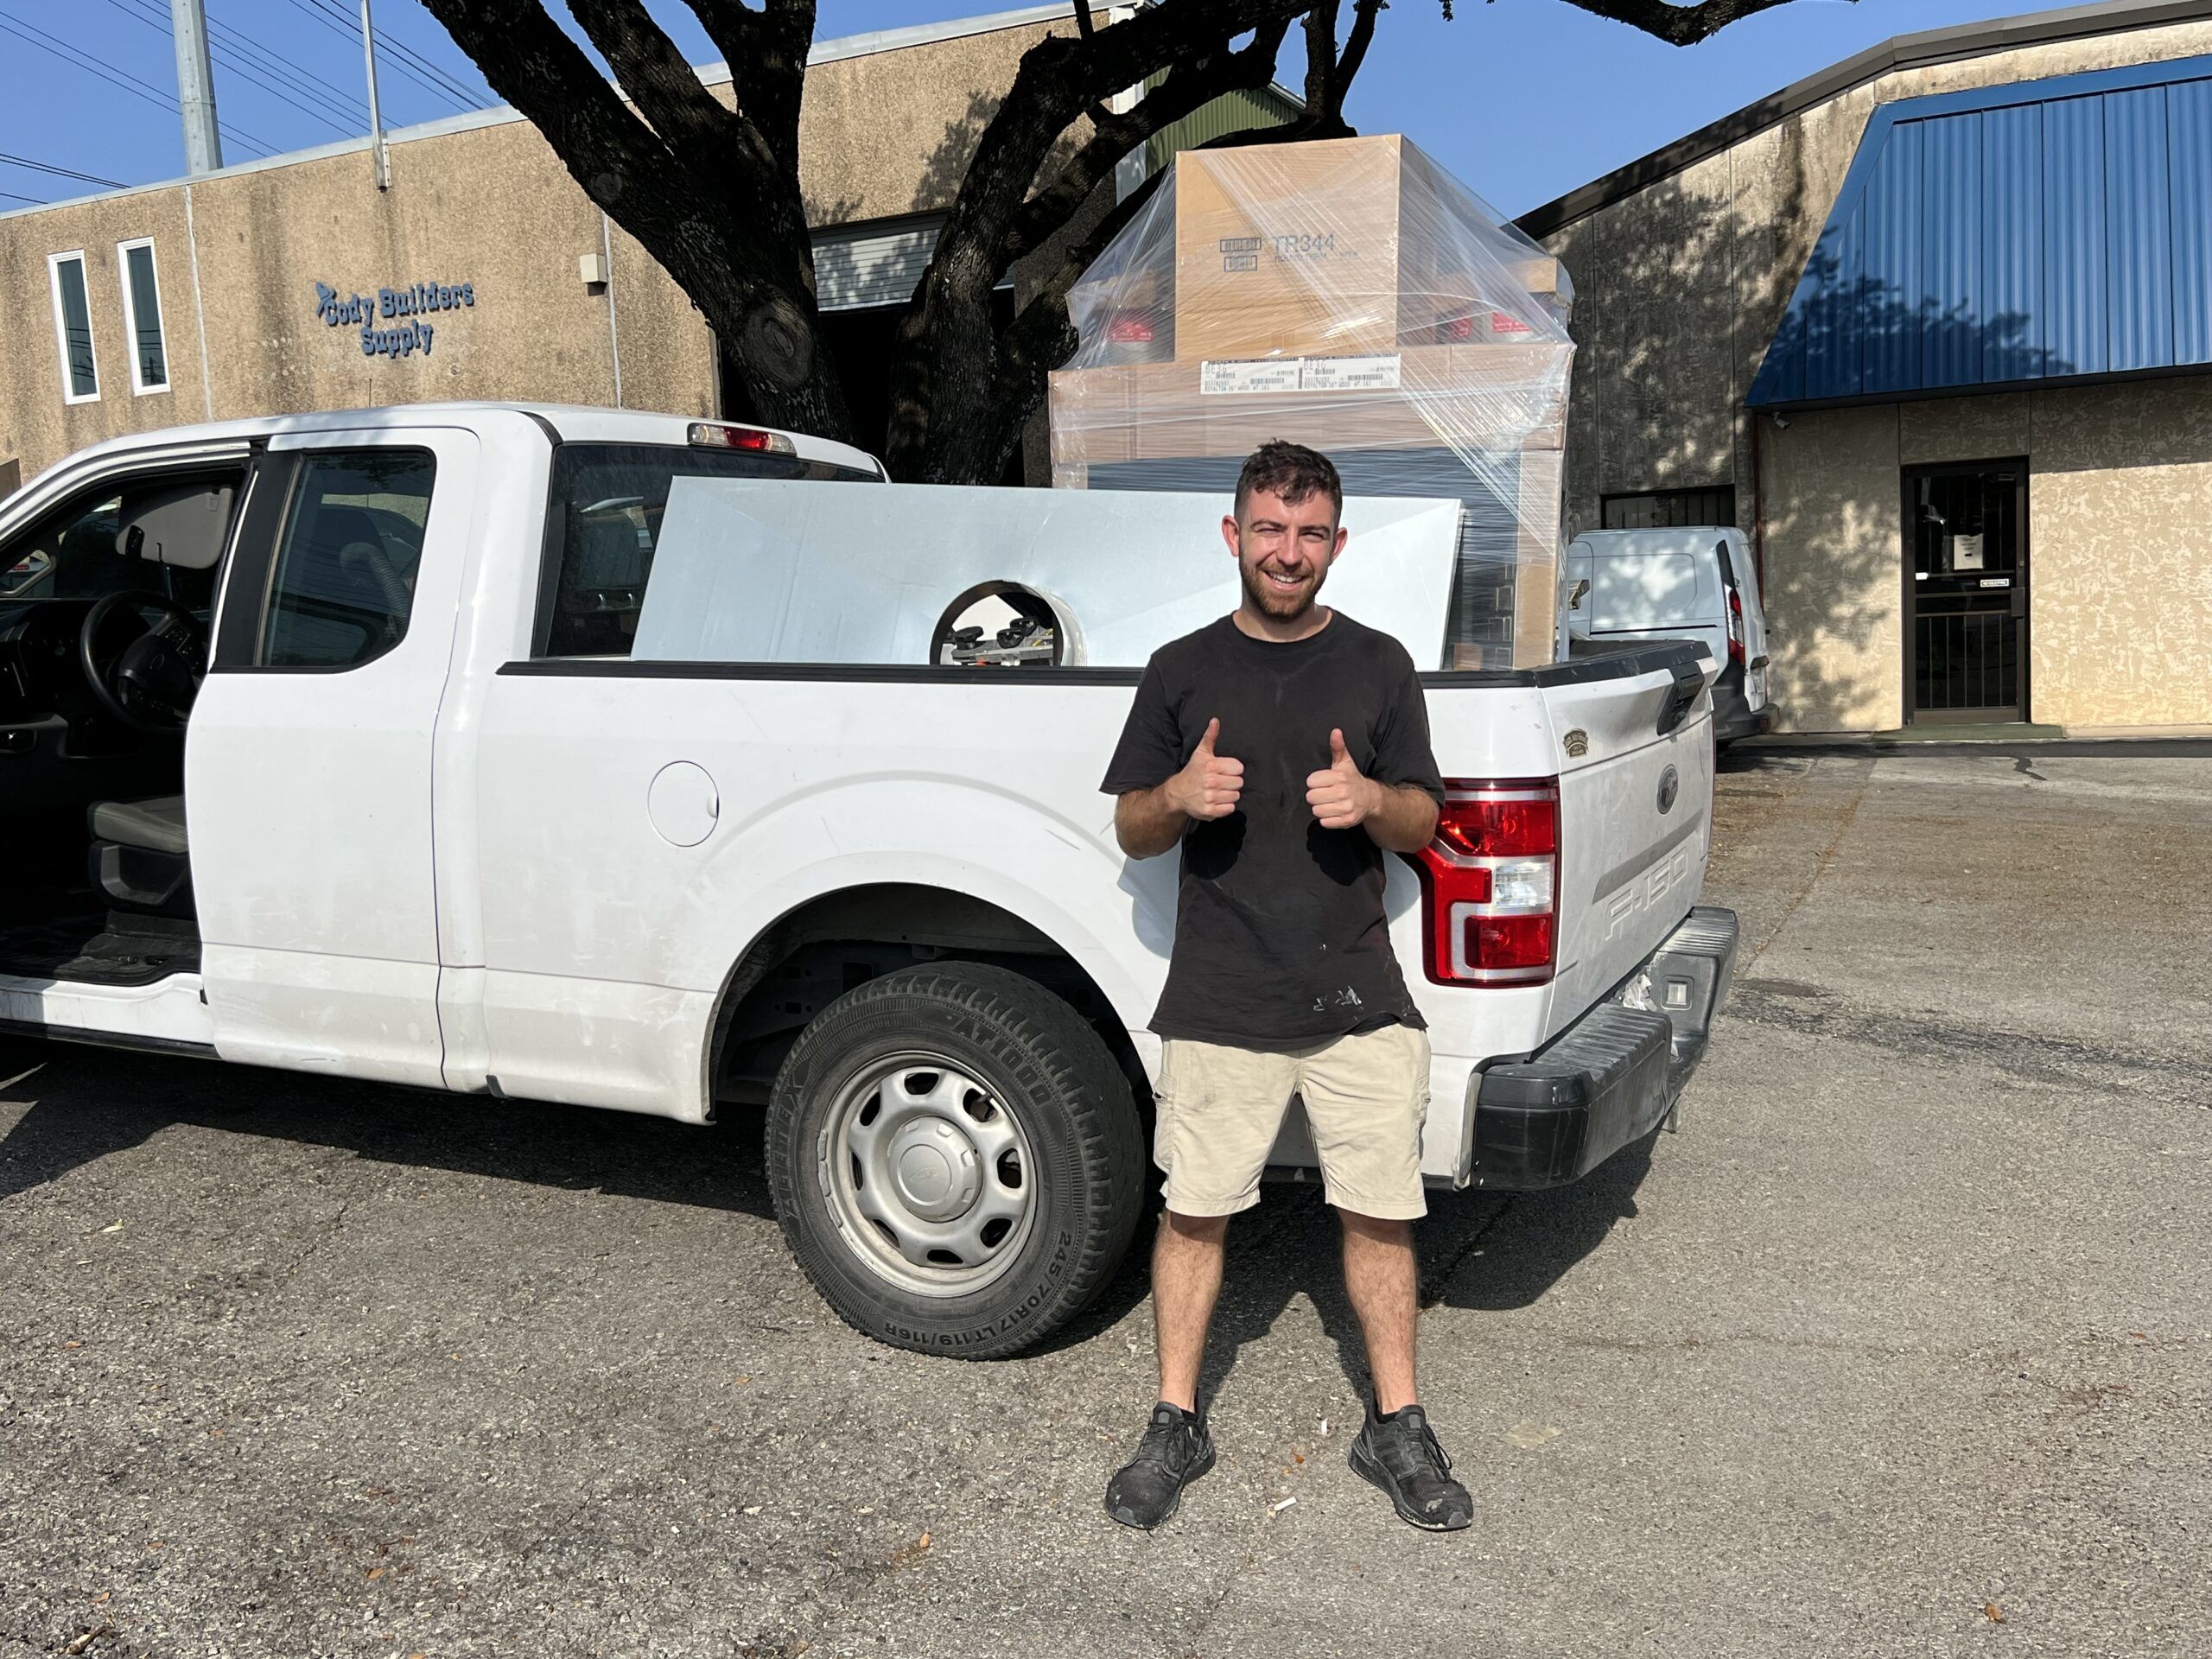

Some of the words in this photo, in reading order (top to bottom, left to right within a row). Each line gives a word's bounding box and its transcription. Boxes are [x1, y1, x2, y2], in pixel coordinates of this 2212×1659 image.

[1272, 233, 1334, 253] TR344
[323, 292, 375, 327] Cody
[378, 281, 474, 318] Builders
[360, 319, 435, 359] Supply
[1605, 845, 1688, 942] F-150
[952, 1016, 1052, 1106] AT1000
